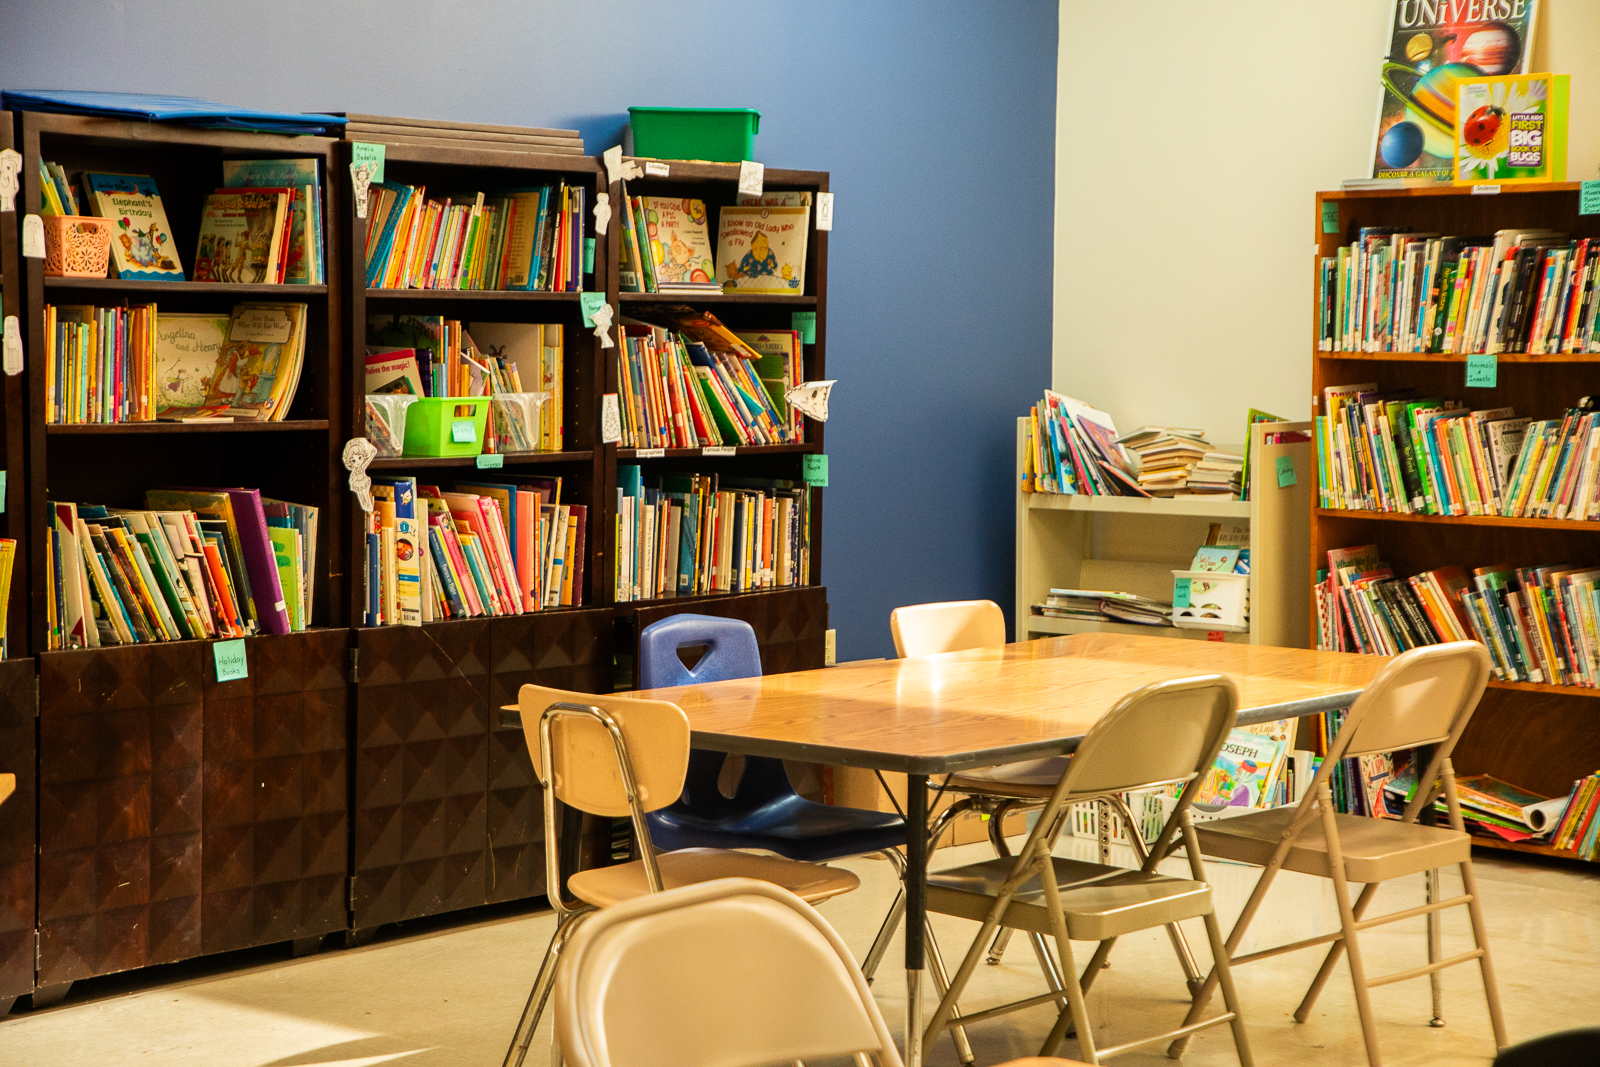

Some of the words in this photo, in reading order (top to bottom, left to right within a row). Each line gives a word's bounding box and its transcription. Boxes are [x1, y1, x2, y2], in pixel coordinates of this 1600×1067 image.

[1512, 120, 1543, 130] FIRST
[1510, 129, 1542, 146] BIG
[1510, 152, 1541, 162] BUGS
[1378, 171, 1408, 179] DISCOVER
[1415, 170, 1440, 178] GALAXY
[112, 197, 152, 207] Elephant's
[119, 208, 153, 218] Birthday
[754, 221, 765, 230] Old
[766, 224, 780, 234] Lady
[720, 228, 754, 240] Swallowed
[734, 238, 745, 247] Fly
[175, 342, 190, 352] and
[192, 343, 221, 355] Henry
[381, 364, 390, 373] the
[391, 361, 411, 371] magic!
[1469, 361, 1494, 369] Animals
[637, 449, 663, 457] Biographies
[218, 653, 245, 667] Holiday
[221, 667, 241, 676] Books
